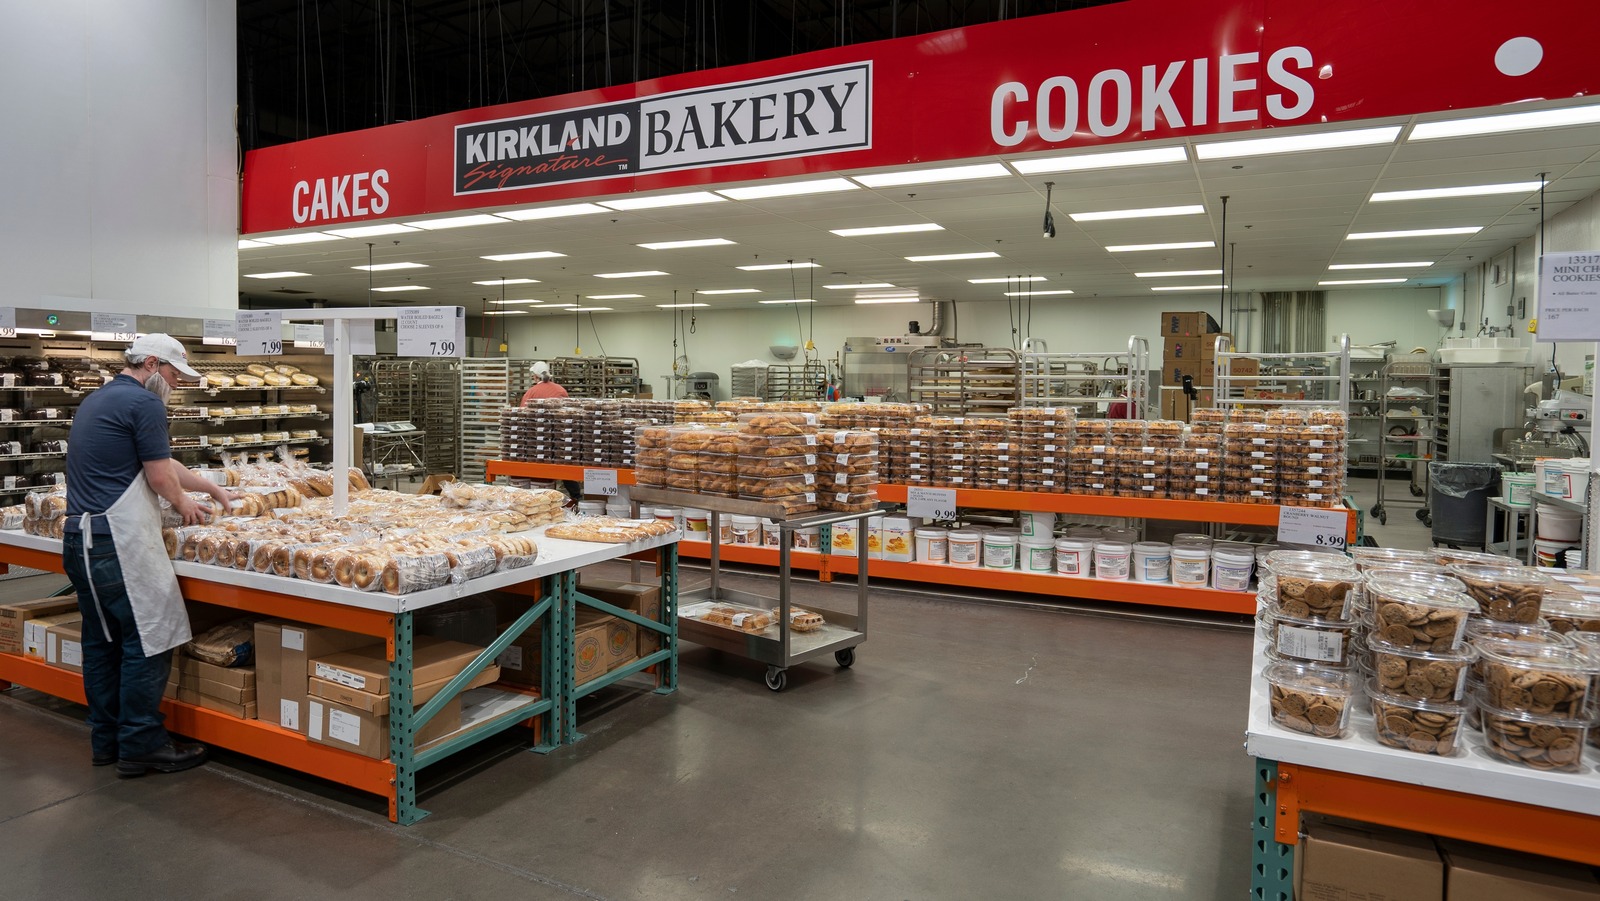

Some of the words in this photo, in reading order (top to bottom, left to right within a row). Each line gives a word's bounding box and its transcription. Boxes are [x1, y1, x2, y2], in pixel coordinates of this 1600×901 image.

[990, 45, 1316, 147] COOKIES
[644, 81, 859, 157] BAKERY
[466, 113, 632, 165] KIRKLAND
[463, 154, 629, 189] Signature
[292, 168, 390, 224] CAKES
[1568, 255, 1600, 264] 13317
[1583, 265, 1600, 273] CH
[113, 332, 136, 340] 15.99
[221, 337, 236, 345] 16.9
[262, 341, 282, 354] 7.99
[430, 342, 455, 356] 7.99
[602, 486, 617, 494] 9.99
[935, 509, 956, 519] 9.99
[1315, 534, 1344, 546] 8.99
